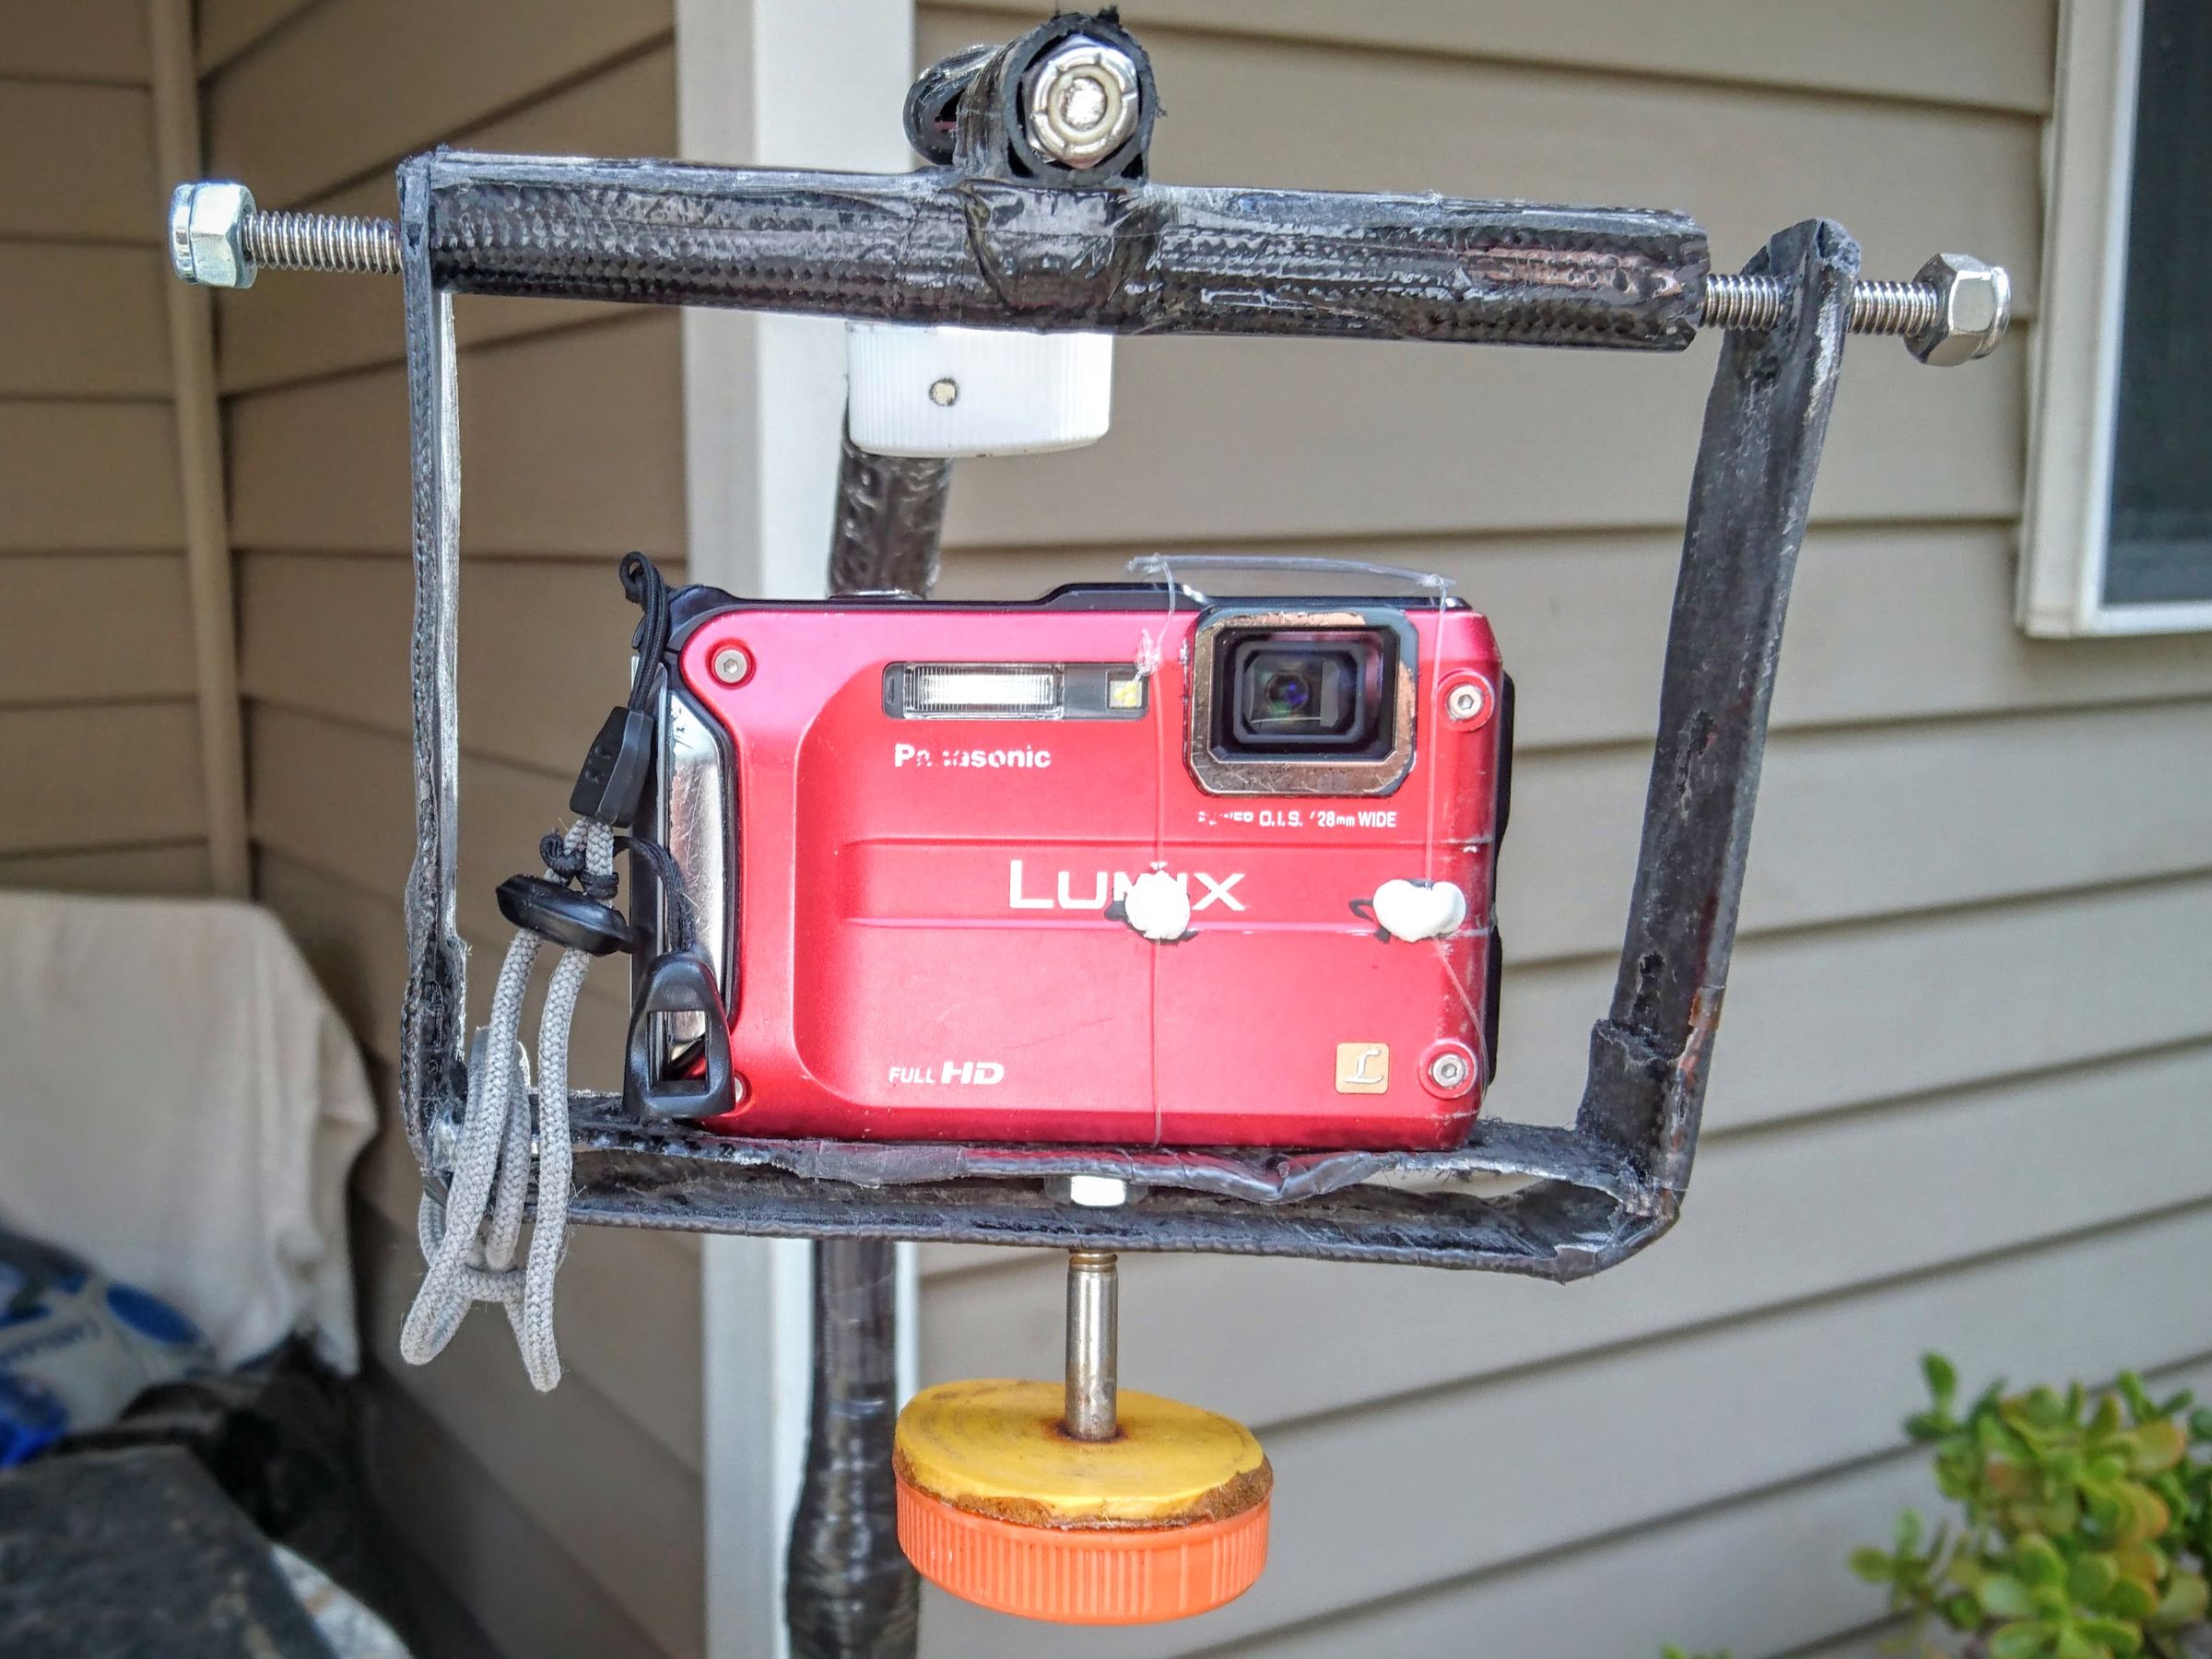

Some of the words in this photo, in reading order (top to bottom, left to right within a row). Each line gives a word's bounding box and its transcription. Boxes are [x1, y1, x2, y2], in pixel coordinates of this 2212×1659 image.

[1358, 811, 1397, 828] WIDE
[888, 1066, 936, 1084] FULL
[940, 1061, 1006, 1086] HD
